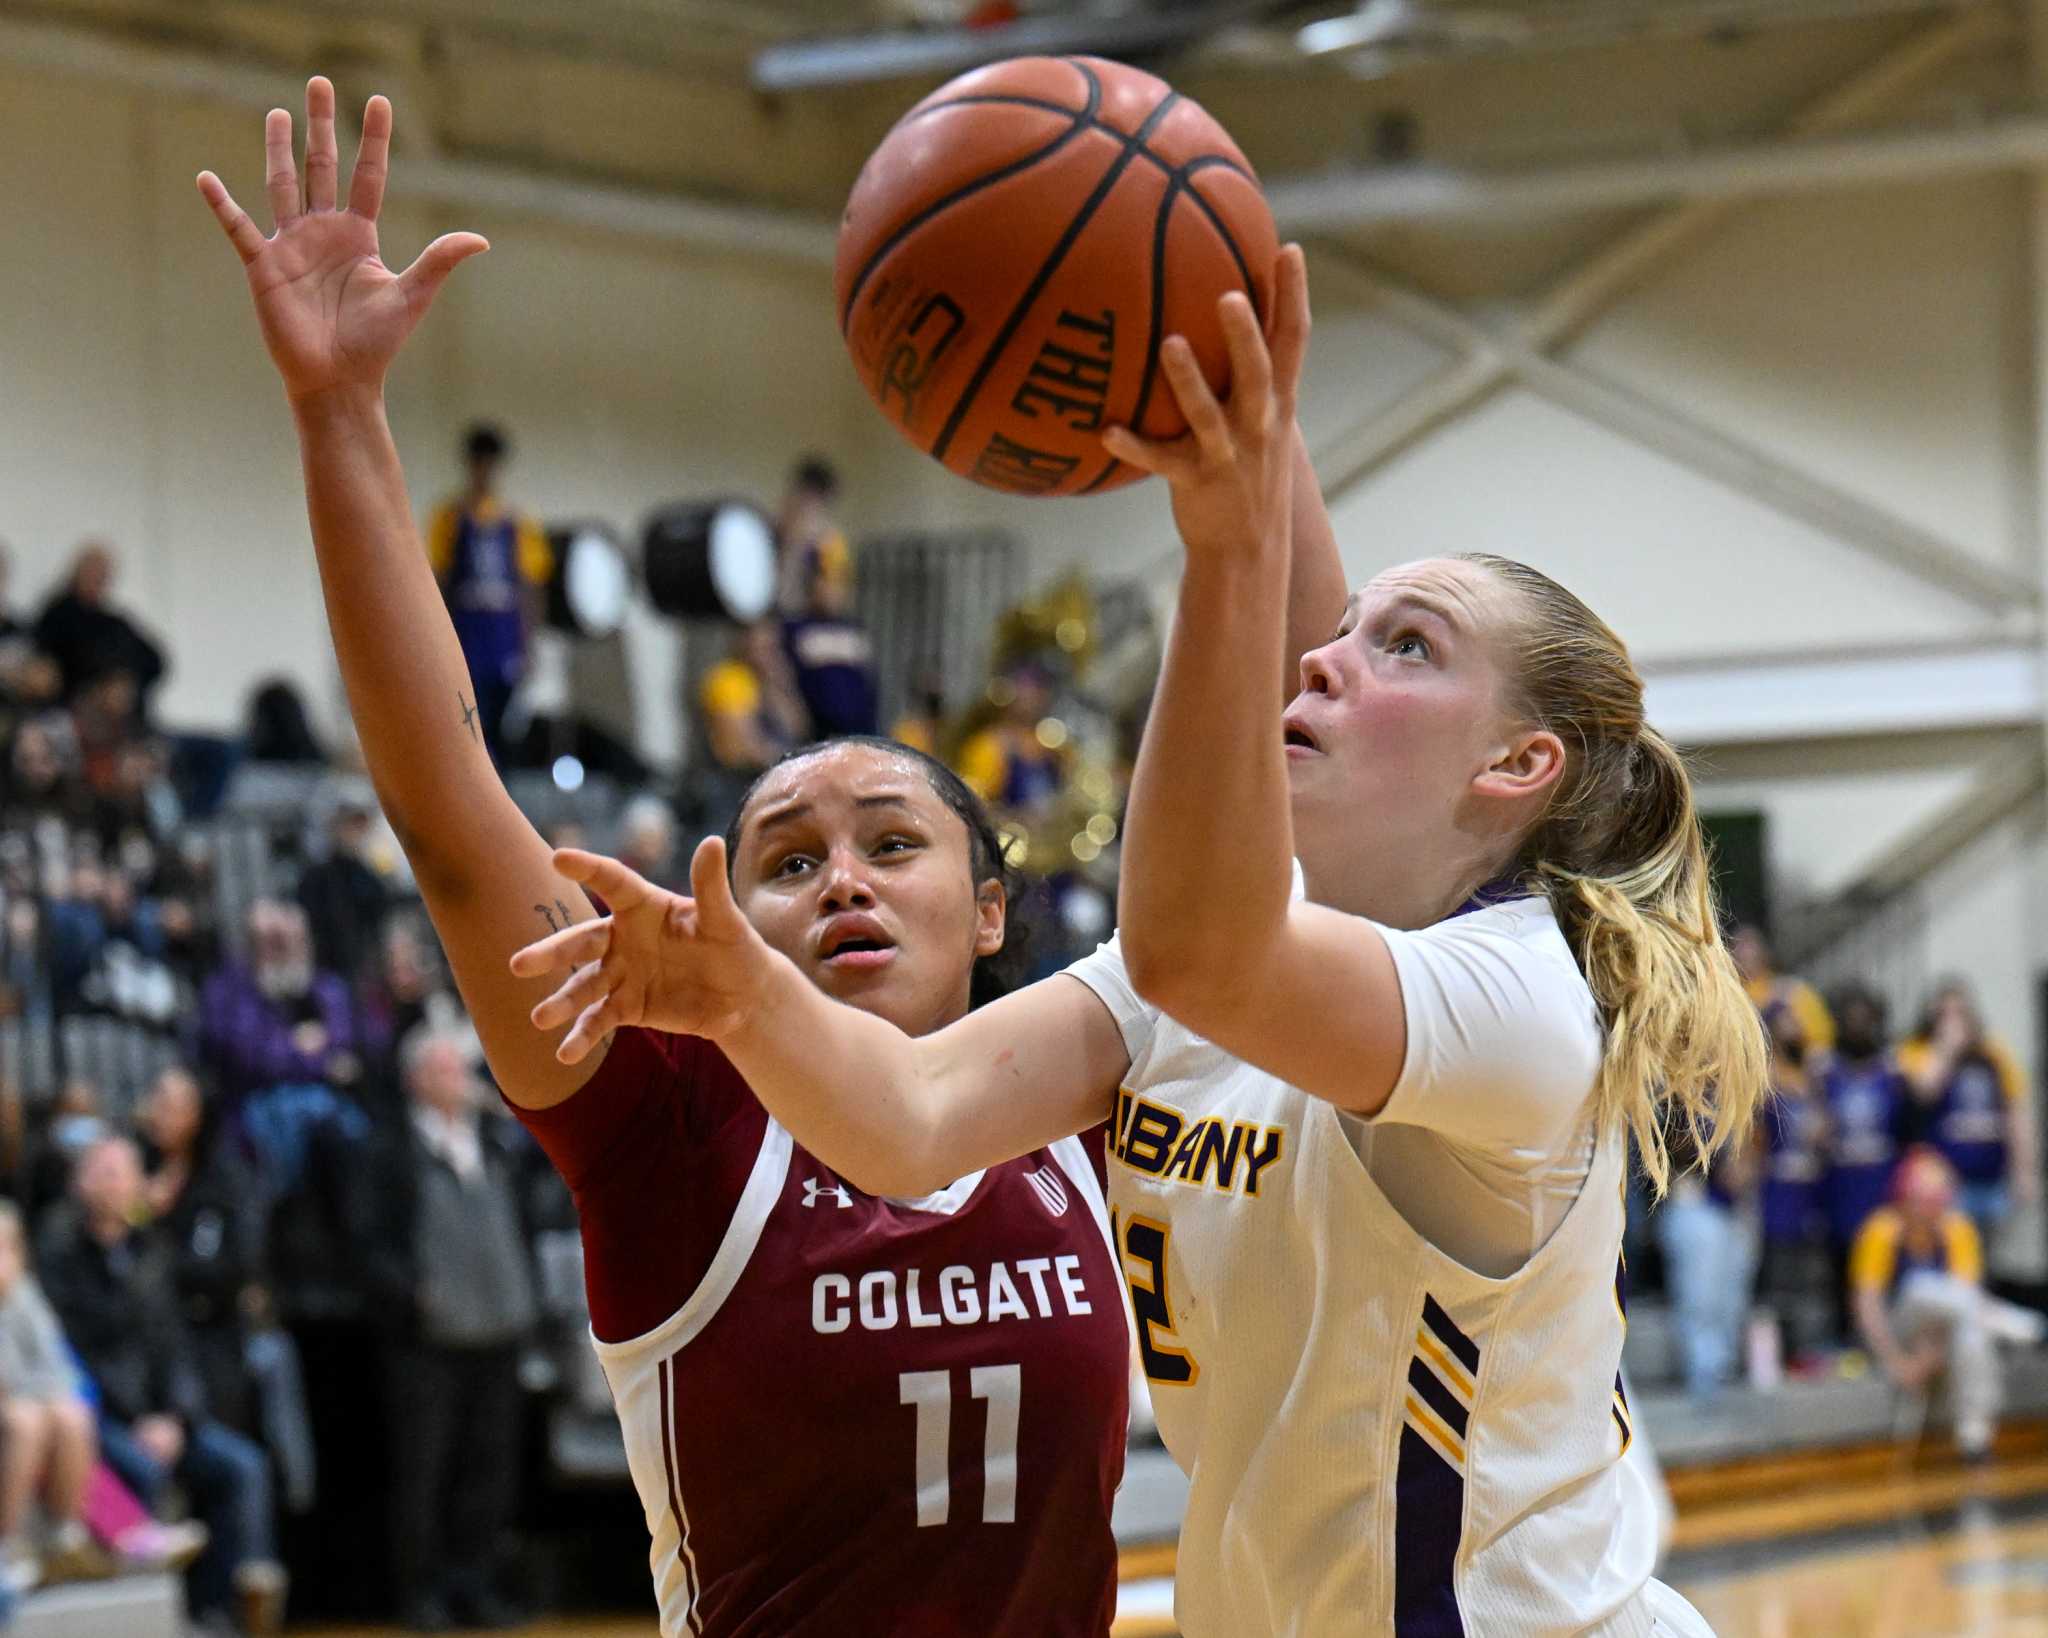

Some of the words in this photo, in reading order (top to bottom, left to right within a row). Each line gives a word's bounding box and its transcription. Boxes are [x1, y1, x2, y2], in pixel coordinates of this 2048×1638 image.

[1011, 308, 1116, 434] THE
[811, 1254, 1093, 1334] COLGATE
[899, 1363, 1022, 1528] 11
